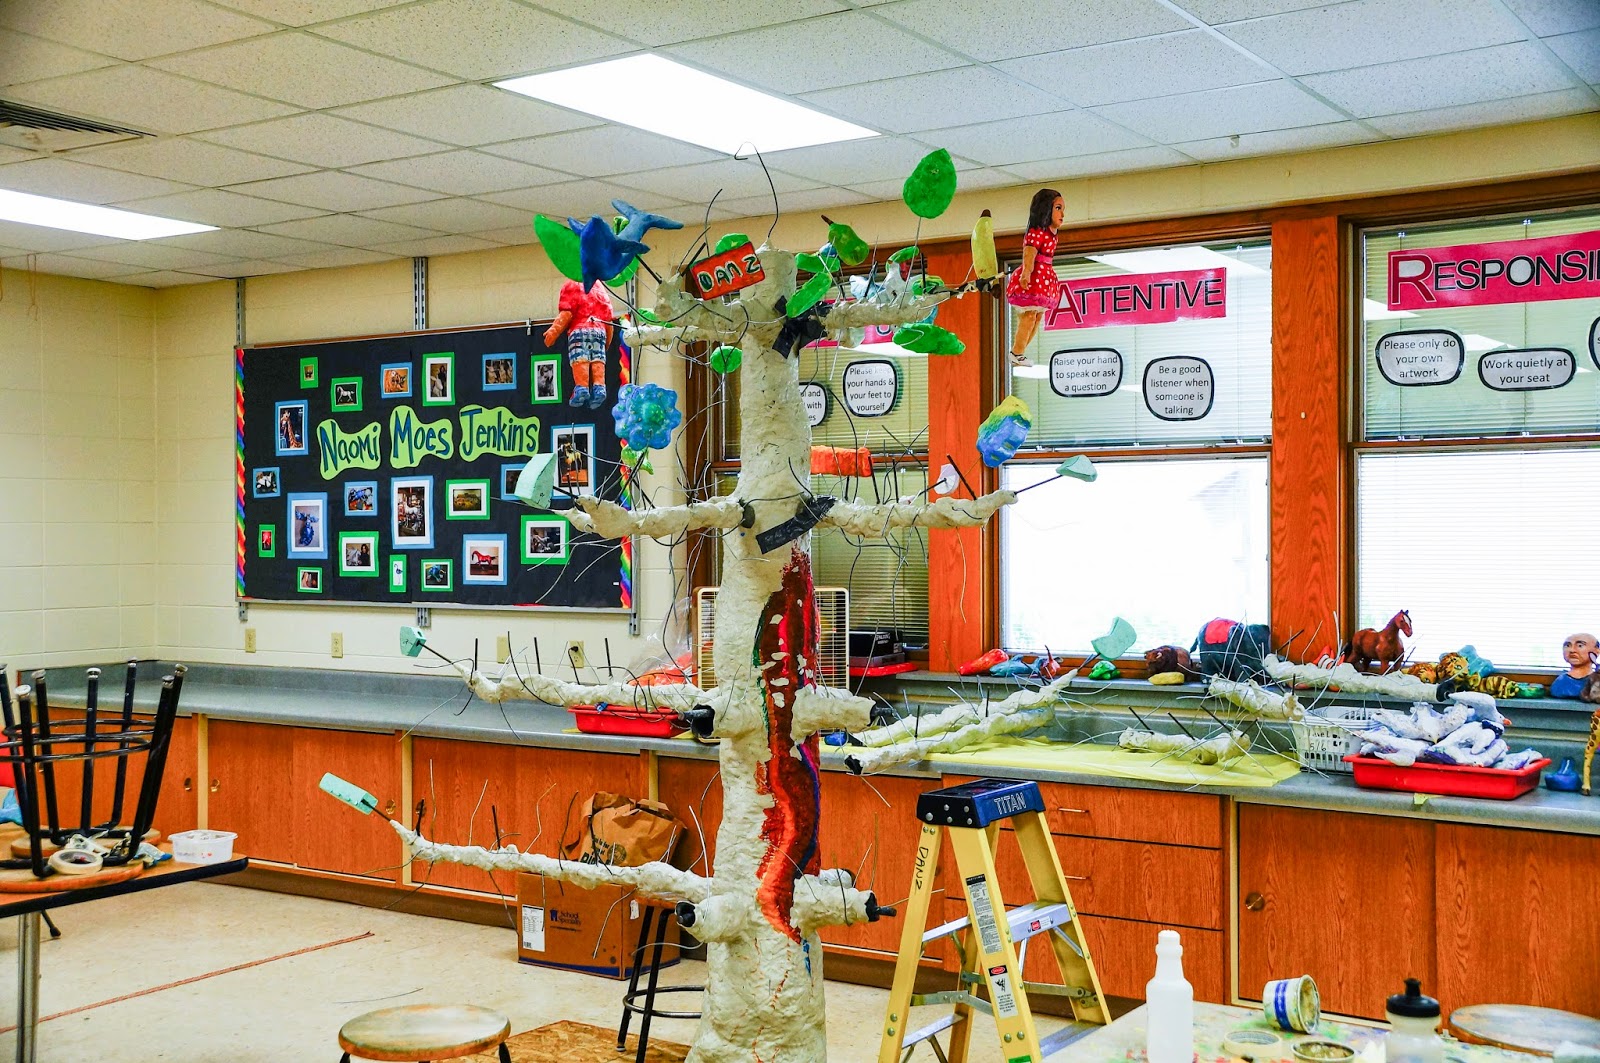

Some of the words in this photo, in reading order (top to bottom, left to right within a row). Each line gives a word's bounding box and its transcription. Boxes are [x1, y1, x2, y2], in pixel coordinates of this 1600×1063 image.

[1048, 278, 1223, 326] ATTENTIVE
[1384, 340, 1416, 350] Please
[1418, 338, 1441, 350] only
[1442, 338, 1456, 348] do
[1053, 357, 1075, 366] Raise
[1077, 357, 1095, 367] your
[1097, 355, 1118, 364] hand
[1395, 355, 1419, 365] your
[1421, 355, 1443, 363] own
[1484, 358, 1513, 369] Work
[1515, 357, 1554, 370] quietly
[1556, 357, 1568, 367] at
[849, 367, 873, 375] Please
[1055, 371, 1065, 379] to
[1066, 370, 1090, 380] speak
[1102, 368, 1116, 377] ask
[1158, 365, 1170, 374] Be
[1179, 364, 1201, 375] good
[1399, 368, 1439, 378] artwork
[847, 380, 863, 389] your
[865, 378, 887, 387] hands
[1150, 378, 1183, 388] listener
[1184, 378, 1209, 387] when
[1499, 375, 1524, 386] your
[1527, 373, 1551, 383] seat
[808, 389, 821, 397] and
[1071, 382, 1107, 393] question
[850, 392, 866, 401] your
[868, 391, 882, 399] feet
[1155, 393, 1195, 401] someone
[1197, 391, 1204, 401] is
[807, 401, 822, 409] with
[856, 402, 886, 412] yourself
[1164, 405, 1194, 416] talking
[319, 420, 379, 473] Naomi
[393, 410, 451, 465] Moes
[460, 408, 539, 457] Jenkins
[993, 792, 1028, 815] TITAN
